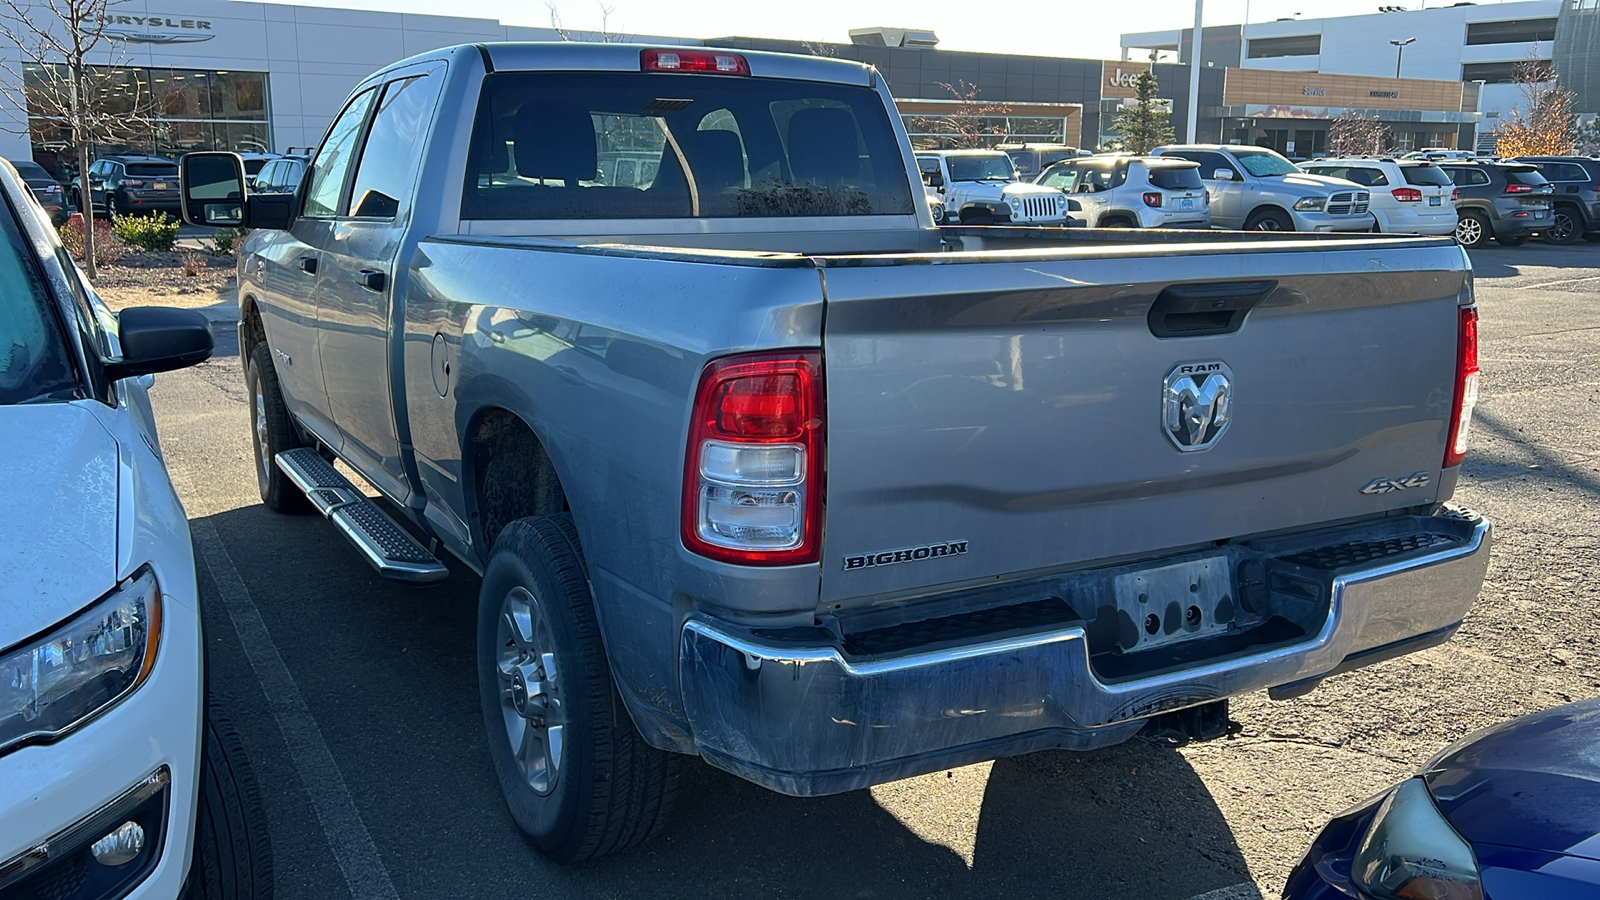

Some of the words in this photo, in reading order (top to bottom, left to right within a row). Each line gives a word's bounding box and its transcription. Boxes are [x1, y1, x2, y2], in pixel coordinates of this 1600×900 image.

[1109, 68, 1138, 87] Jee
[1181, 363, 1221, 374] RAM
[843, 539, 969, 571] BIGHORN
